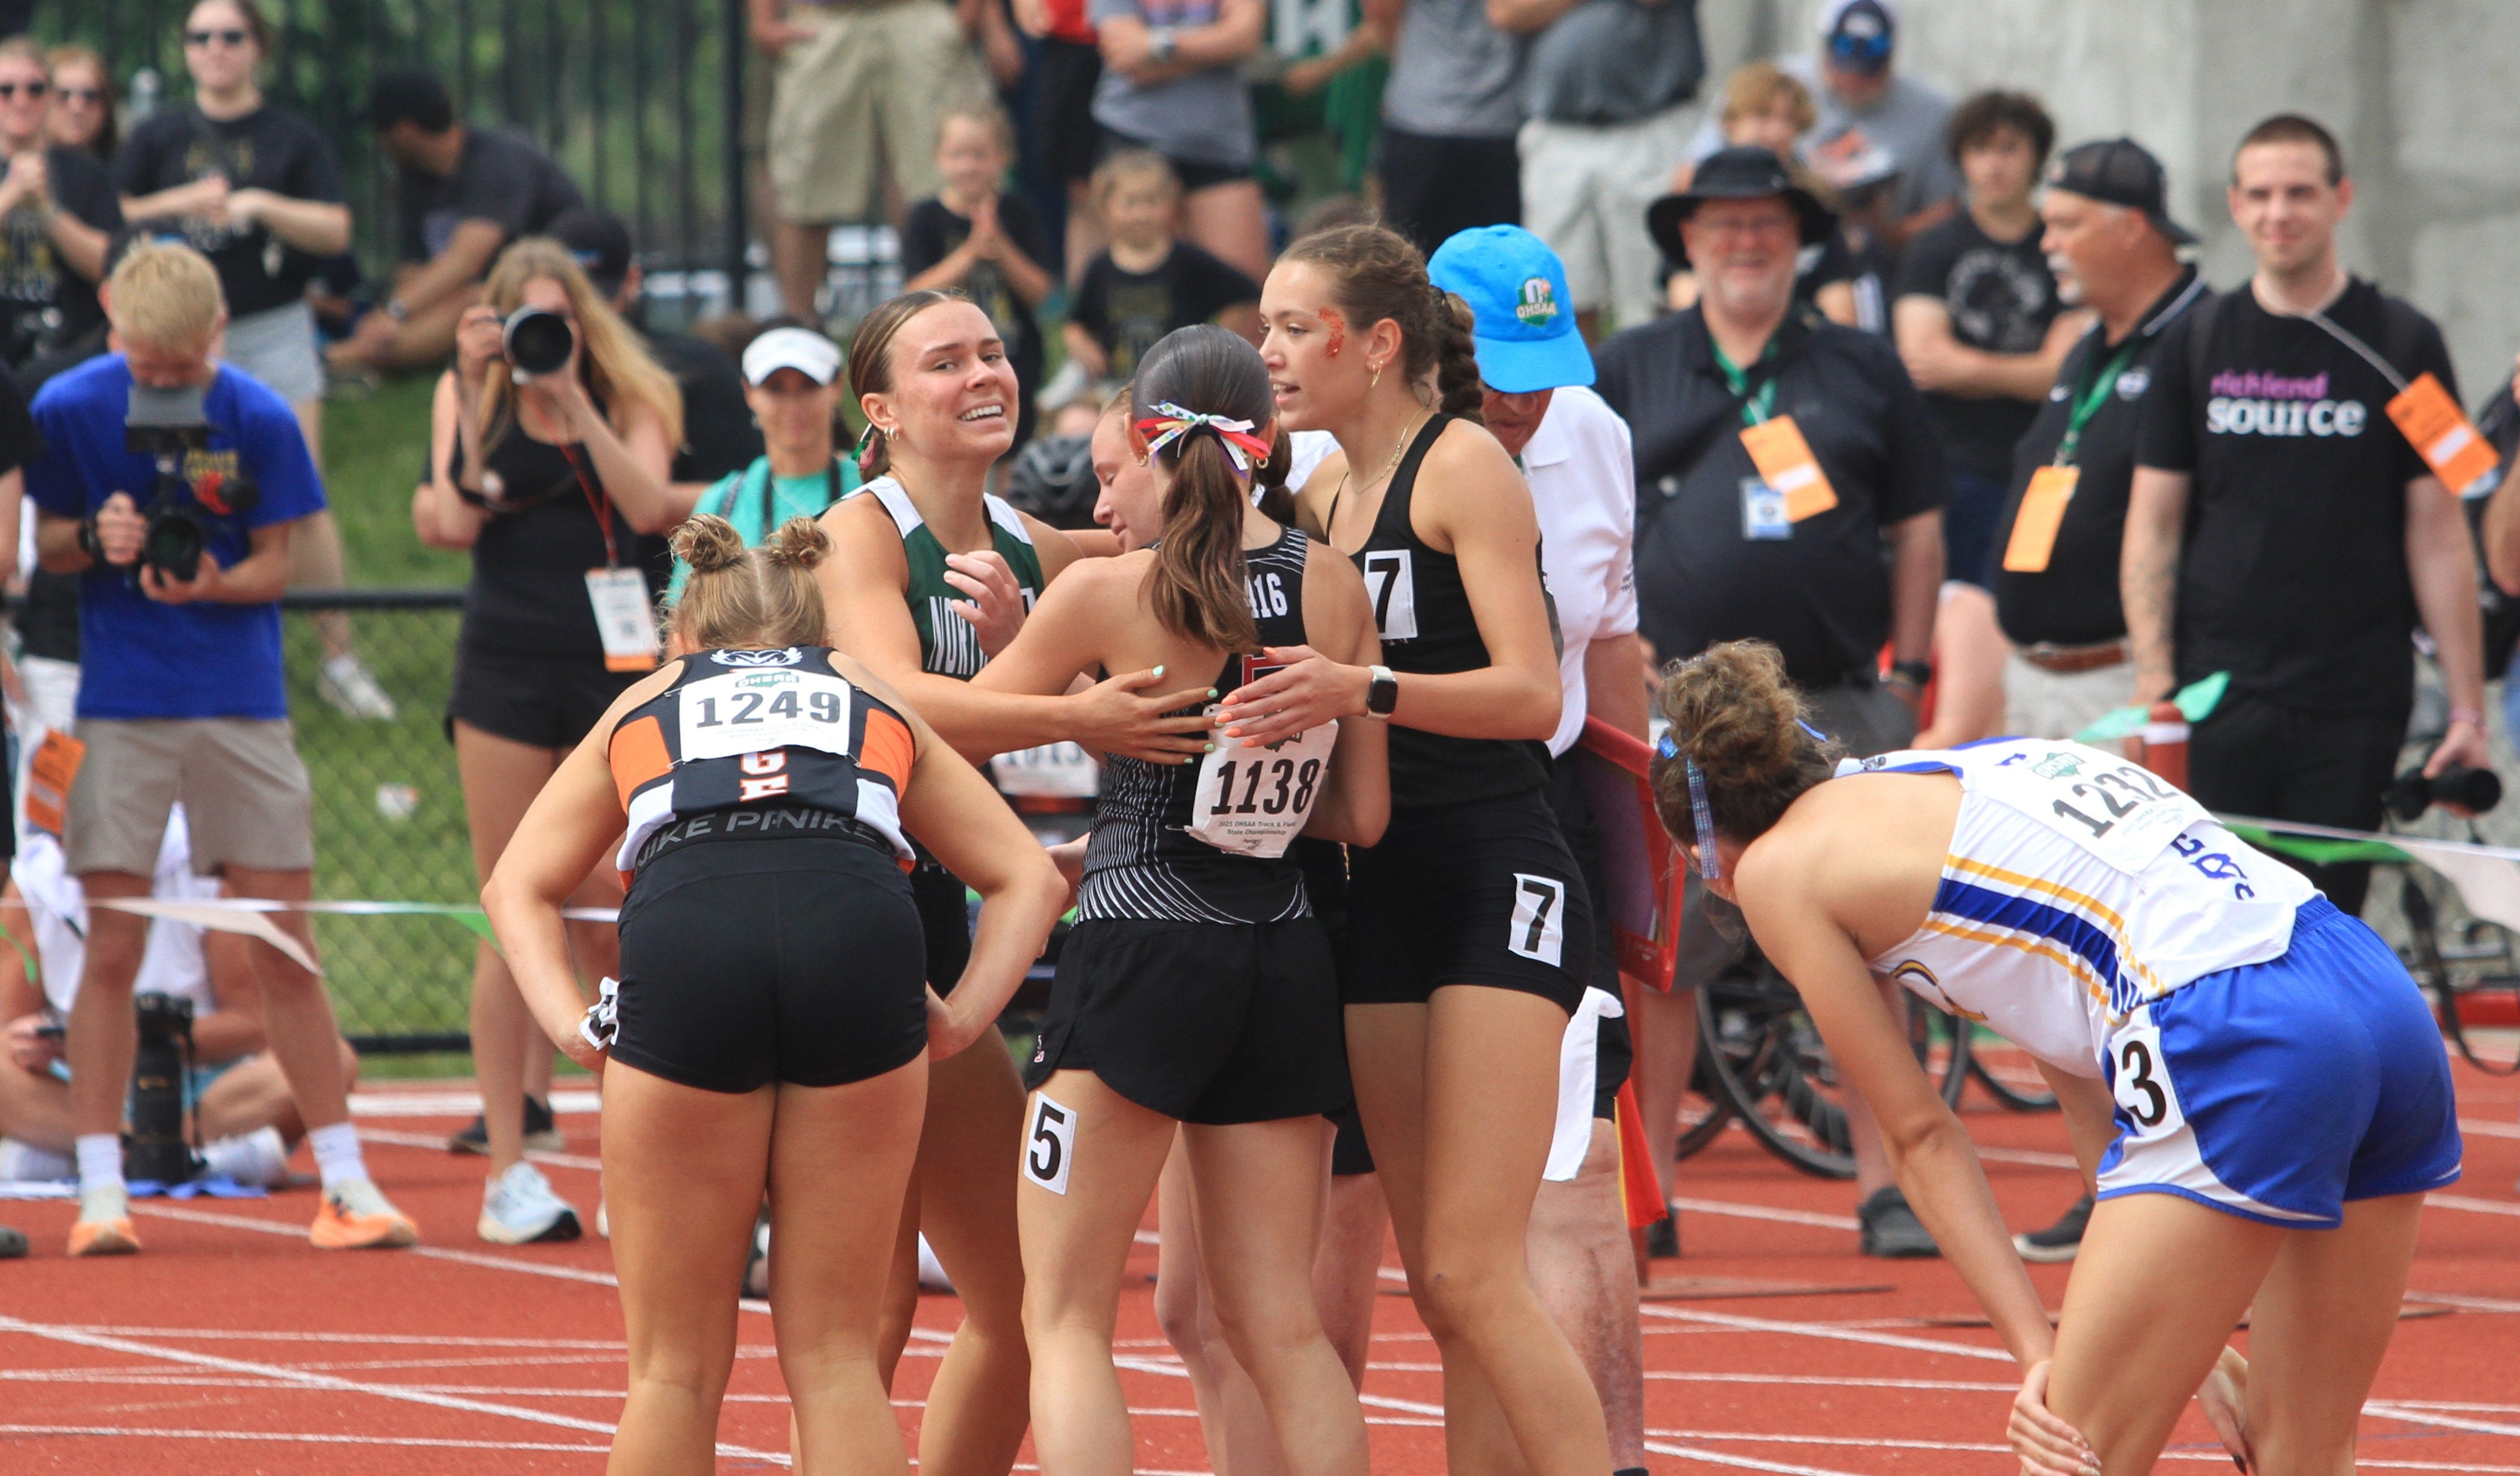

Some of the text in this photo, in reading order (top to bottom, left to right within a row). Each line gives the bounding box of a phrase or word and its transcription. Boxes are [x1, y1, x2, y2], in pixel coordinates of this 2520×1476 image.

[1516, 302, 1557, 318] OHSAA
[2206, 397, 2367, 436] source
[1368, 558, 1400, 633] 7
[736, 673, 799, 687] OHSAA
[696, 691, 840, 728] 1249
[1210, 758, 1320, 815] 1138
[2033, 752, 2086, 781] OHSAA
[2052, 767, 2180, 838] 1232
[1522, 878, 1555, 953] 7
[2122, 1040, 2167, 1128] 3
[1030, 1101, 1065, 1181] 5
